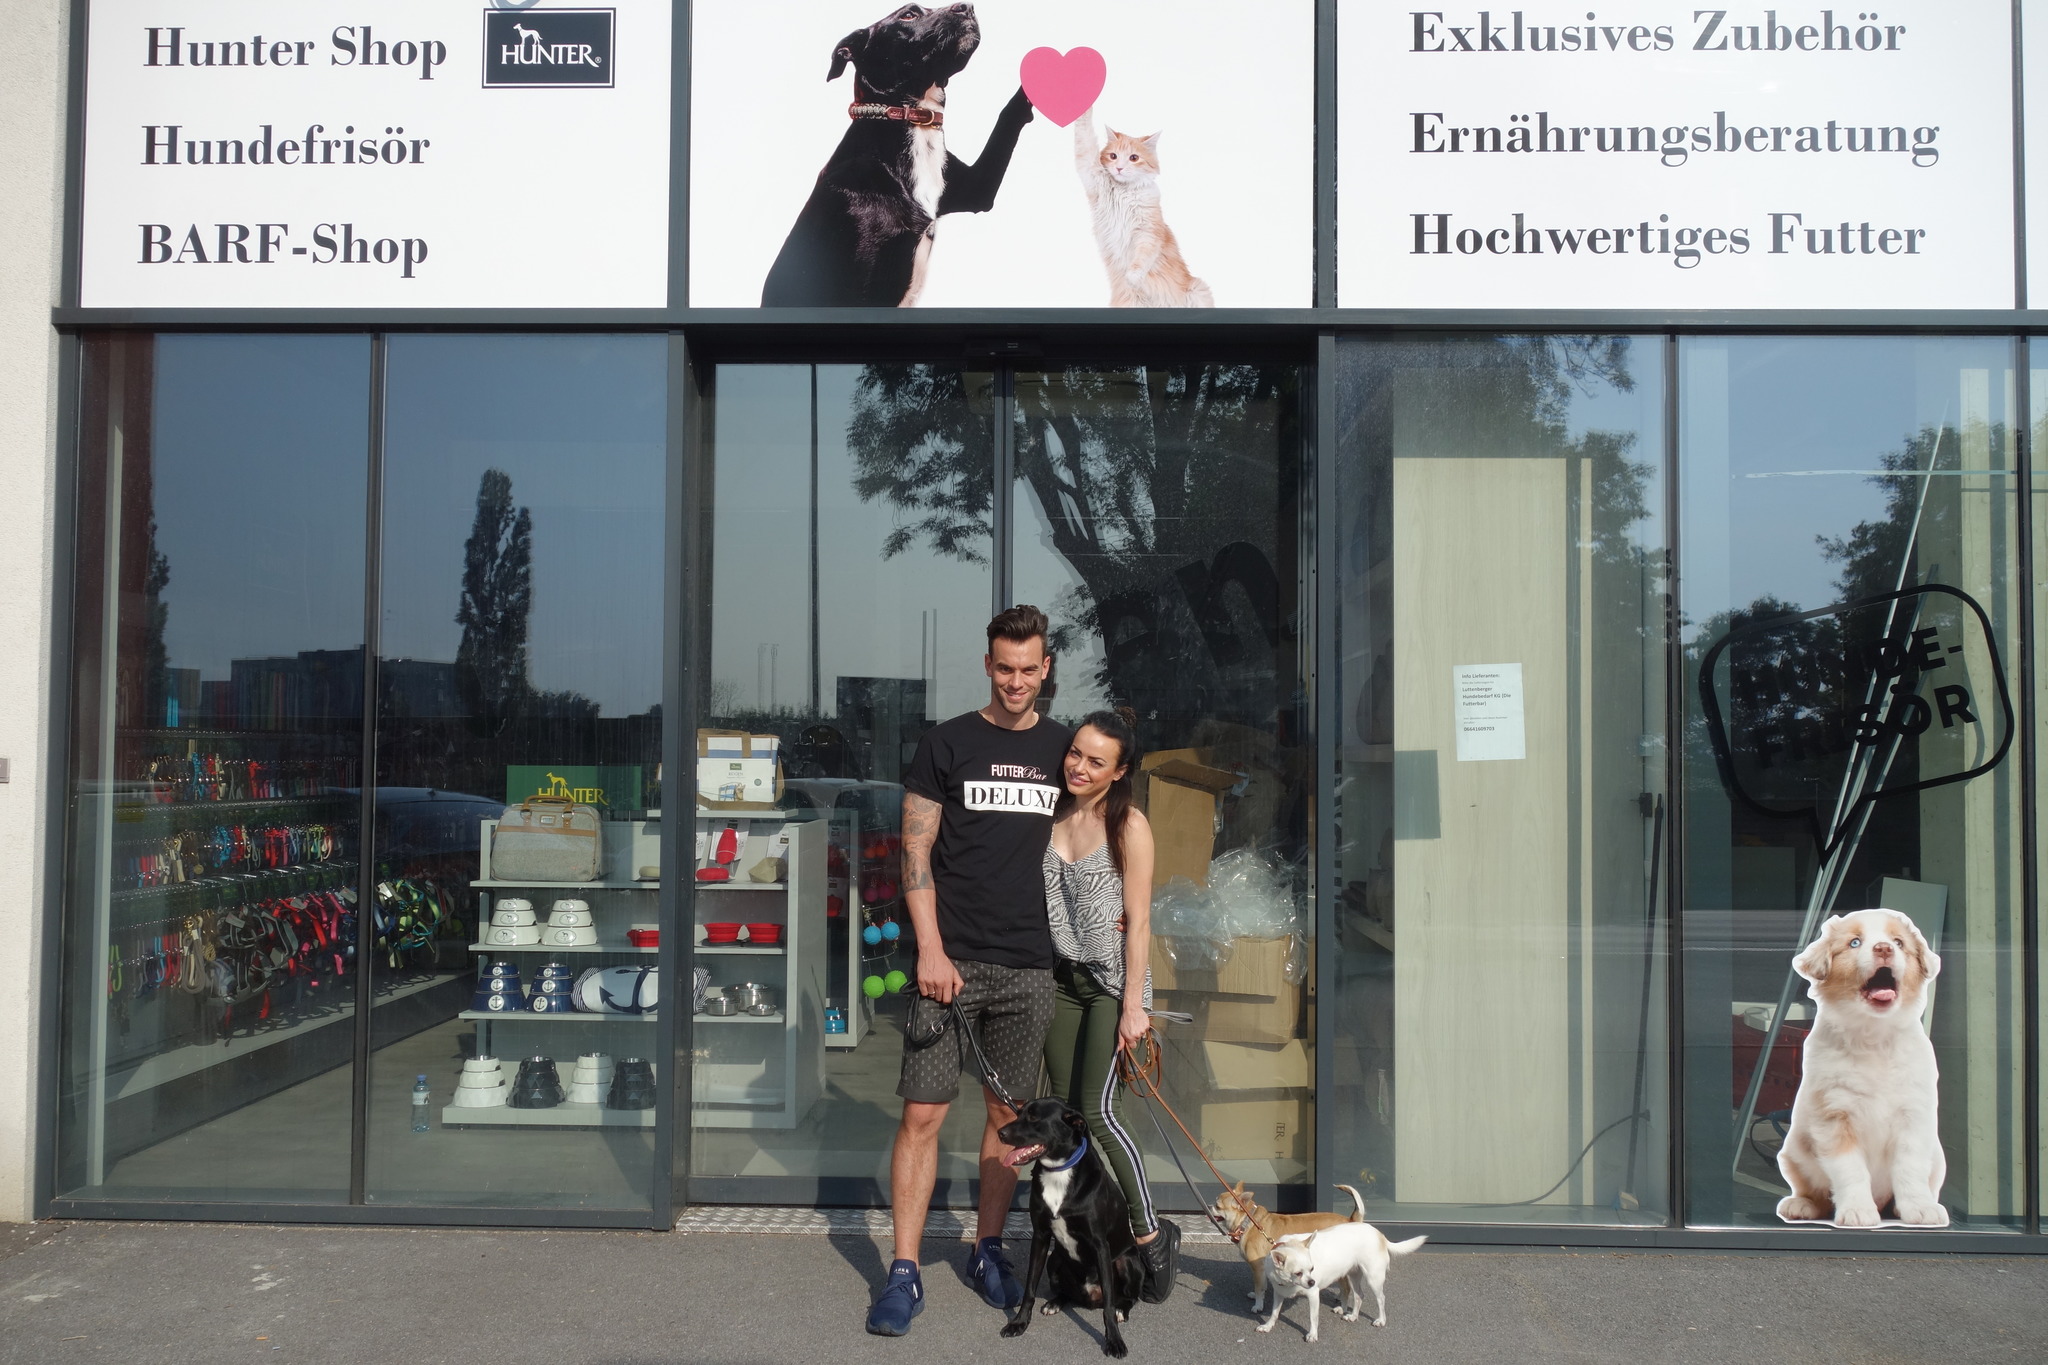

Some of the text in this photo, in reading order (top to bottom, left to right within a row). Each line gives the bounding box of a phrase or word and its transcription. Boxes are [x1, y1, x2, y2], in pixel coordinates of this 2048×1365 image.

[143, 26, 447, 80] Hunter Shop
[1409, 10, 1907, 53] Exklusives Zubehör
[141, 124, 431, 166] Hundefrisör
[1409, 111, 1940, 167] Ernährungsberatung
[137, 223, 429, 278] BARF-Shop
[1409, 213, 1926, 269] Hochwertiges Futter
